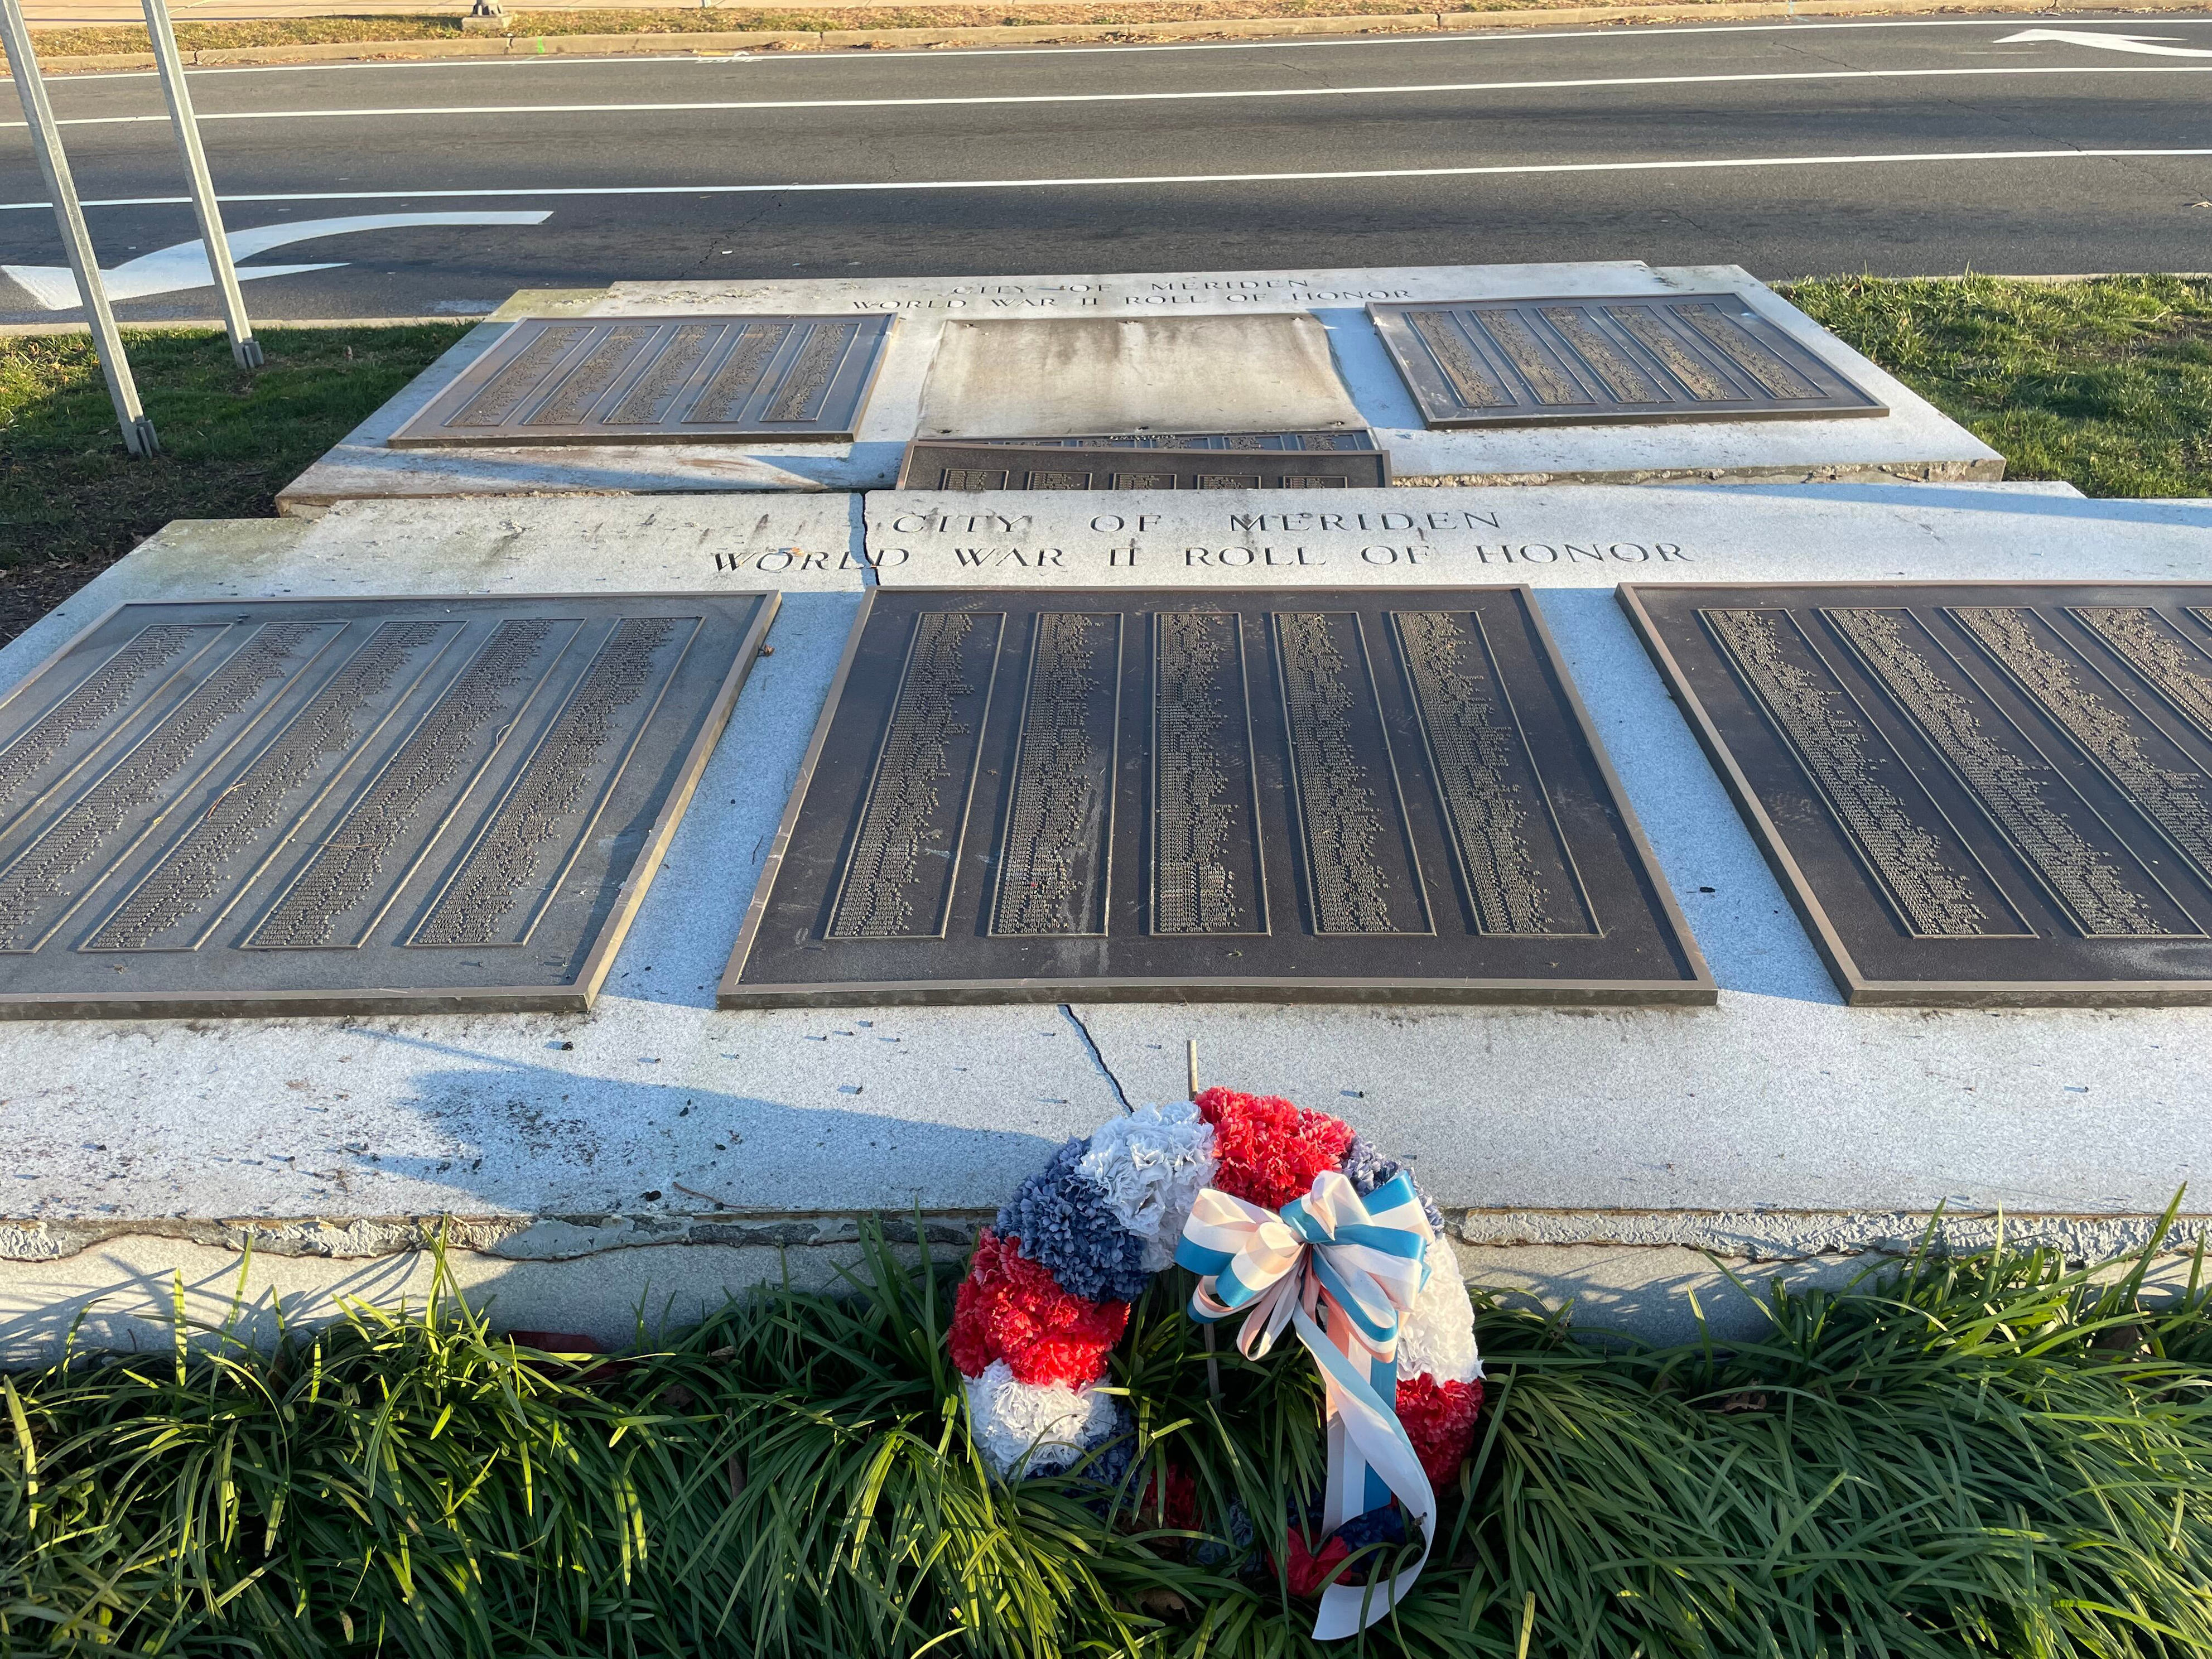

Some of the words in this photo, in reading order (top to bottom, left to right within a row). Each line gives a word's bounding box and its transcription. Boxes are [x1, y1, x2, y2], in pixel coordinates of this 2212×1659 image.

[952, 284, 1032, 295] CITY
[1069, 283, 1112, 293] OF
[1151, 280, 1308, 291] MERIDEN
[852, 299, 967, 310] WORLD
[991, 298, 1057, 307] WAR
[1082, 297, 1097, 306] II
[1125, 295, 1207, 305] ROLL
[1226, 293, 1267, 302] OF
[1292, 290, 1414, 301] HONOR
[892, 514, 1033, 533] CITY
[1090, 514, 1162, 532] OF
[1229, 510, 1501, 531] MERIDEN
[712, 547, 909, 572] WORLD
[953, 547, 1065, 568] WAR
[1109, 546, 1138, 567] II
[1184, 546, 1327, 566] ROLL
[1360, 544, 1430, 565] OF
[1474, 542, 1695, 563] HONOR
